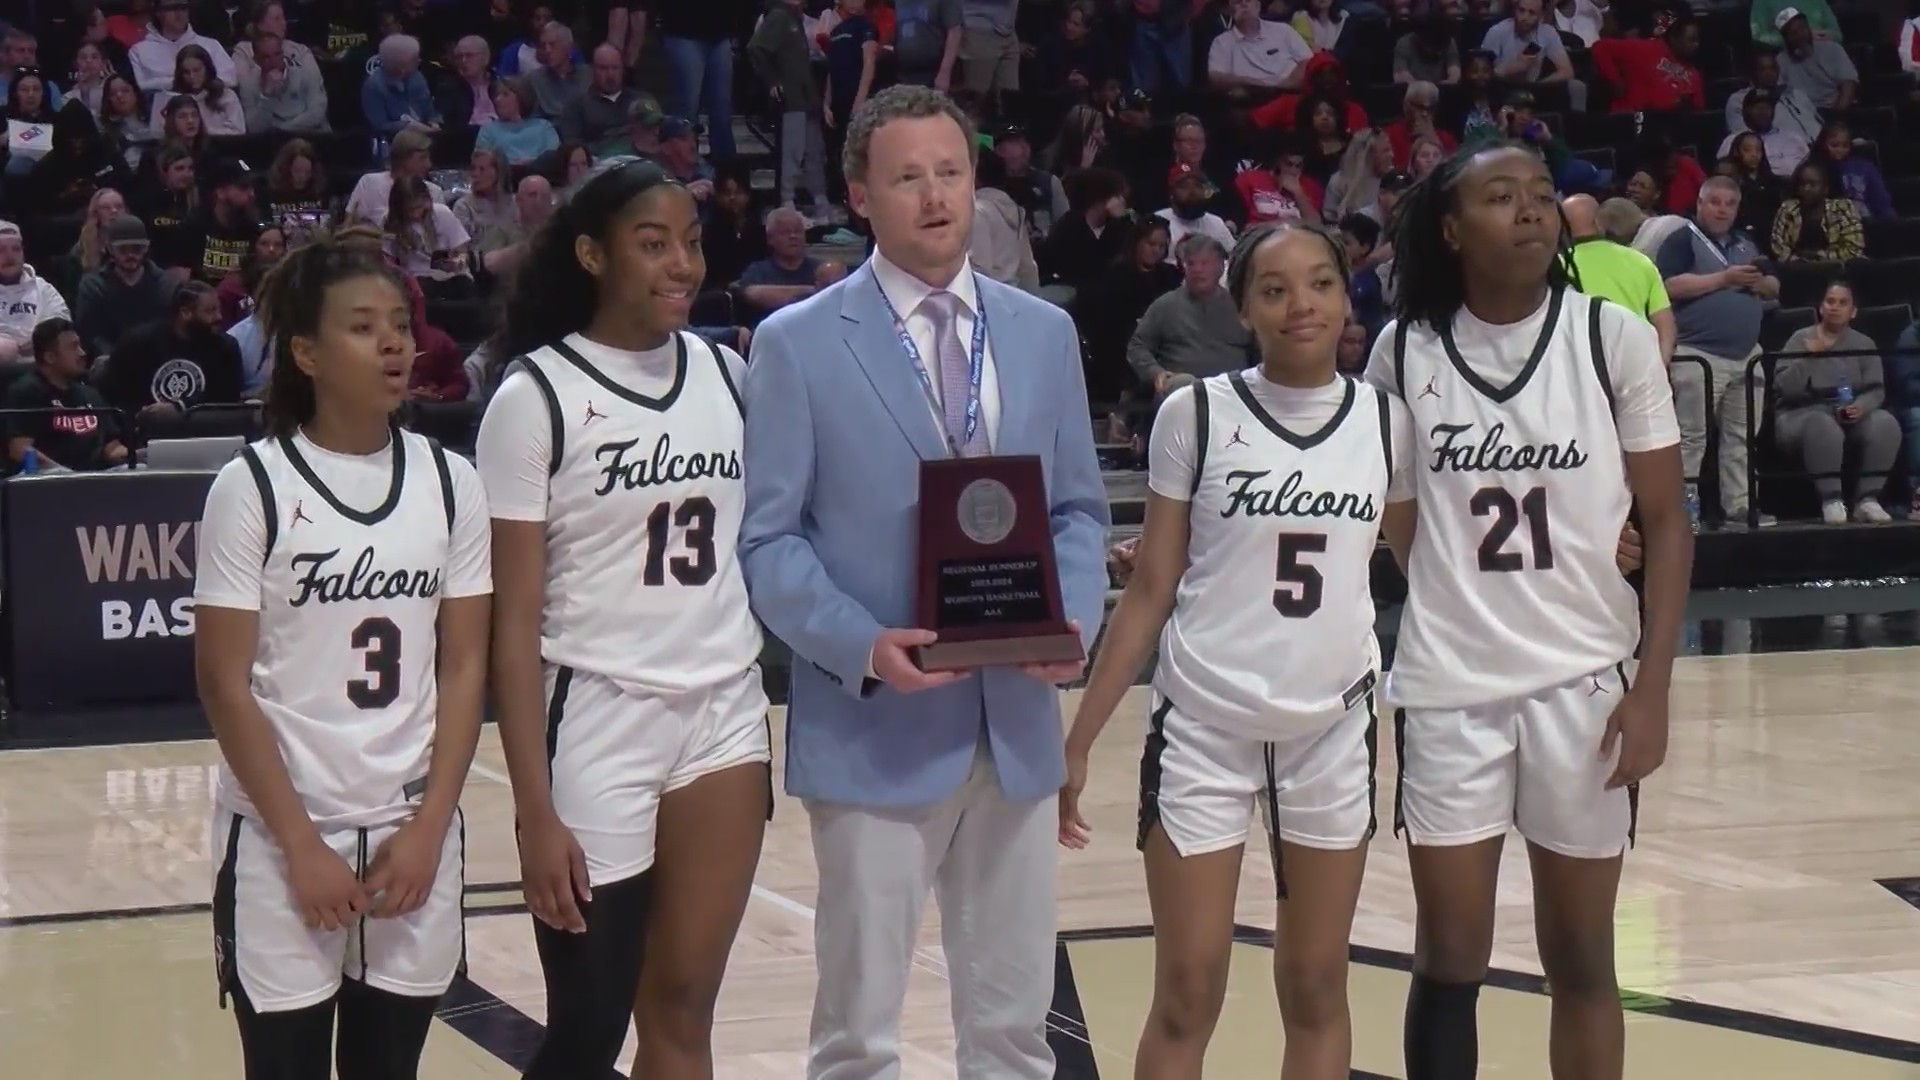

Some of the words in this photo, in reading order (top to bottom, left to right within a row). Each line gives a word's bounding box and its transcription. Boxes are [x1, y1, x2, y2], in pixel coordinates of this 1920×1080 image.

[595, 433, 742, 496] Falcons
[1430, 422, 1588, 473] Falcons
[1220, 470, 1377, 522] Falcons
[1470, 486, 1553, 572] 21
[288, 545, 441, 607] Falcons
[643, 496, 717, 586] 13
[1272, 532, 1327, 618] 5
[347, 616, 402, 709] 3
